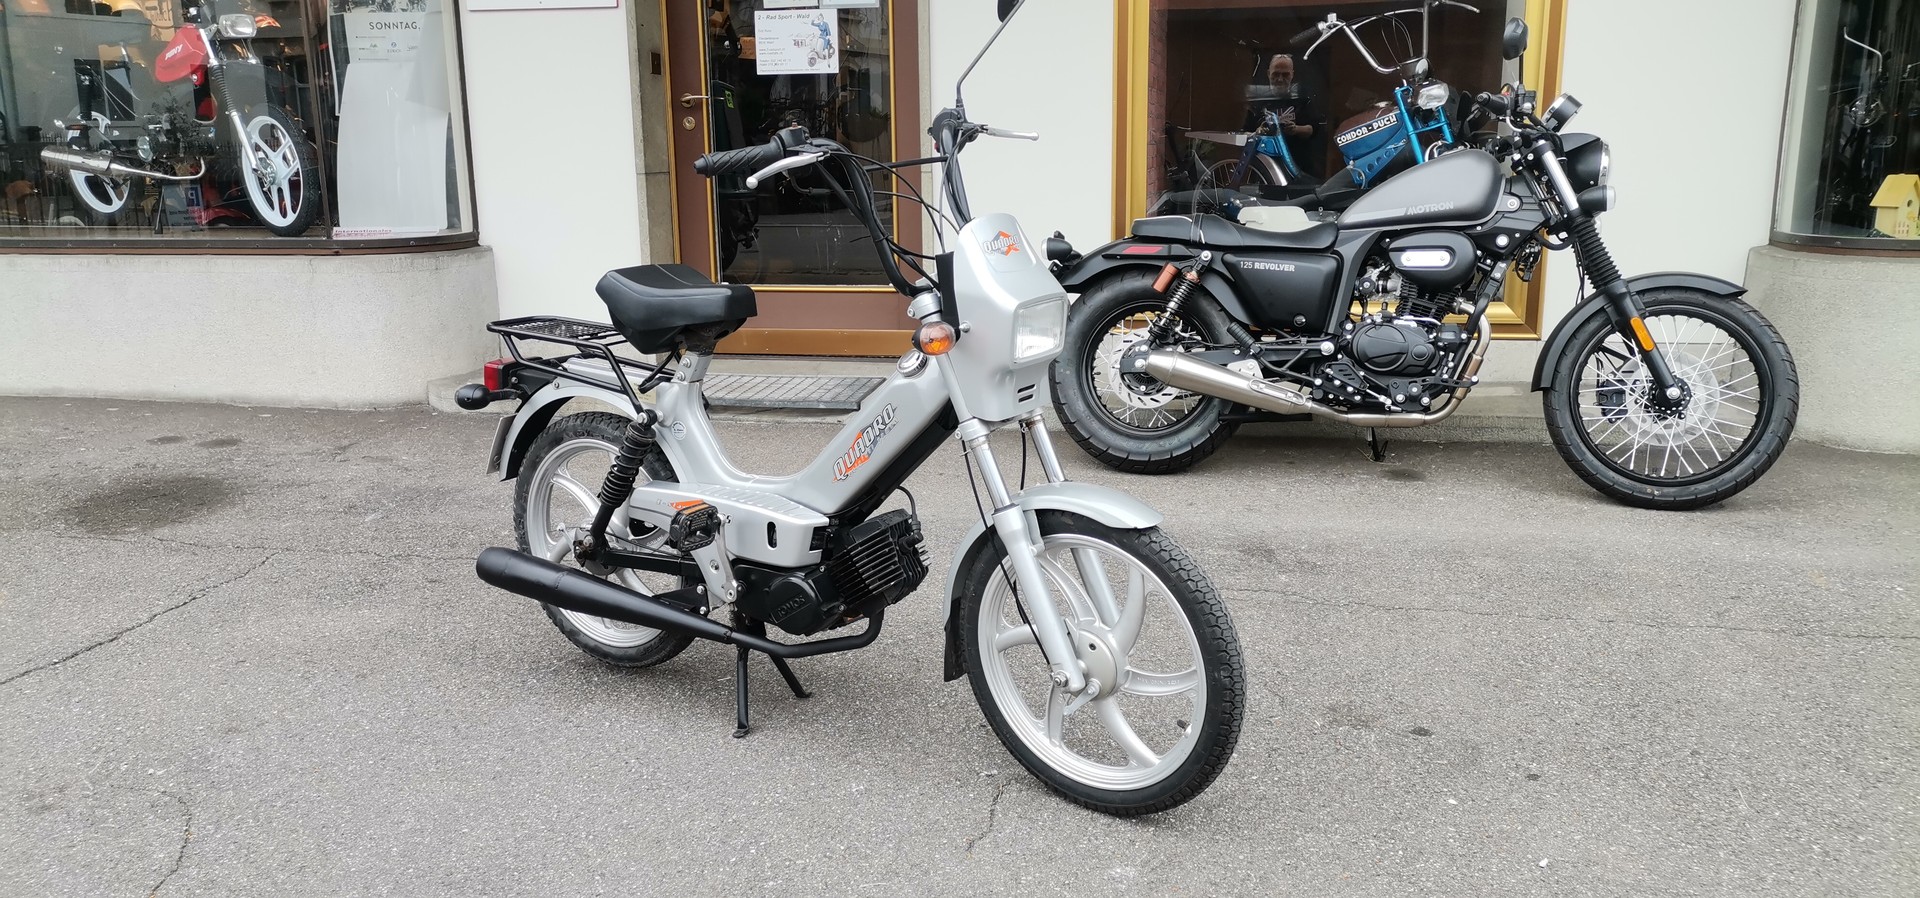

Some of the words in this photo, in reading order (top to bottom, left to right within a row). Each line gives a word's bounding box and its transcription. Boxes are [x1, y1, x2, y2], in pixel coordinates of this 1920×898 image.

[778, 13, 793, 21] Sport
[1407, 200, 1454, 216] MOTRON
[983, 234, 1020, 256] QUADRO
[1240, 261, 1253, 269] 125
[1254, 262, 1296, 272] REVOLVER
[833, 403, 895, 481] QUADRO
